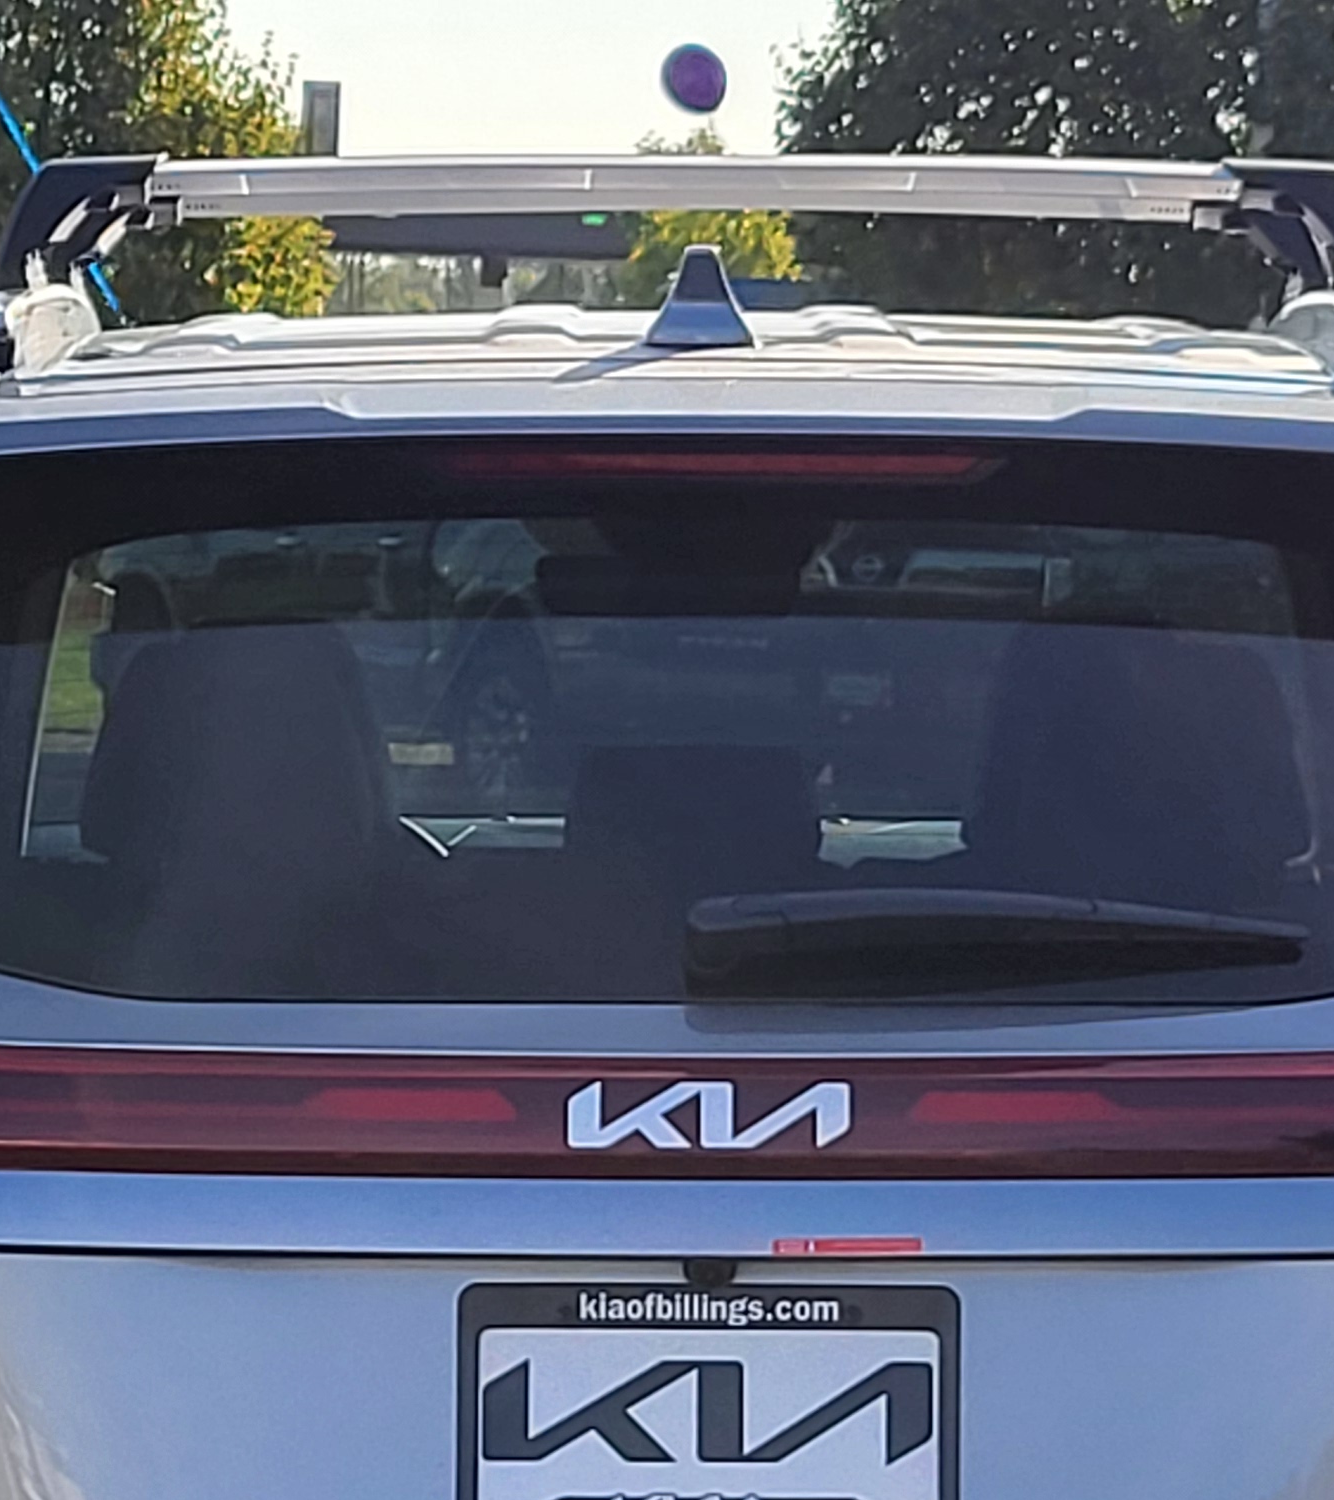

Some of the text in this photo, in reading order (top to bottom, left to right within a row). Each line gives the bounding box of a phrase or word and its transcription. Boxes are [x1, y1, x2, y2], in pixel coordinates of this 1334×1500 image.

[567, 1080, 851, 1149] KIA
[579, 1291, 840, 1327] kiaofbillings.com
[481, 1357, 934, 1466] KIA
